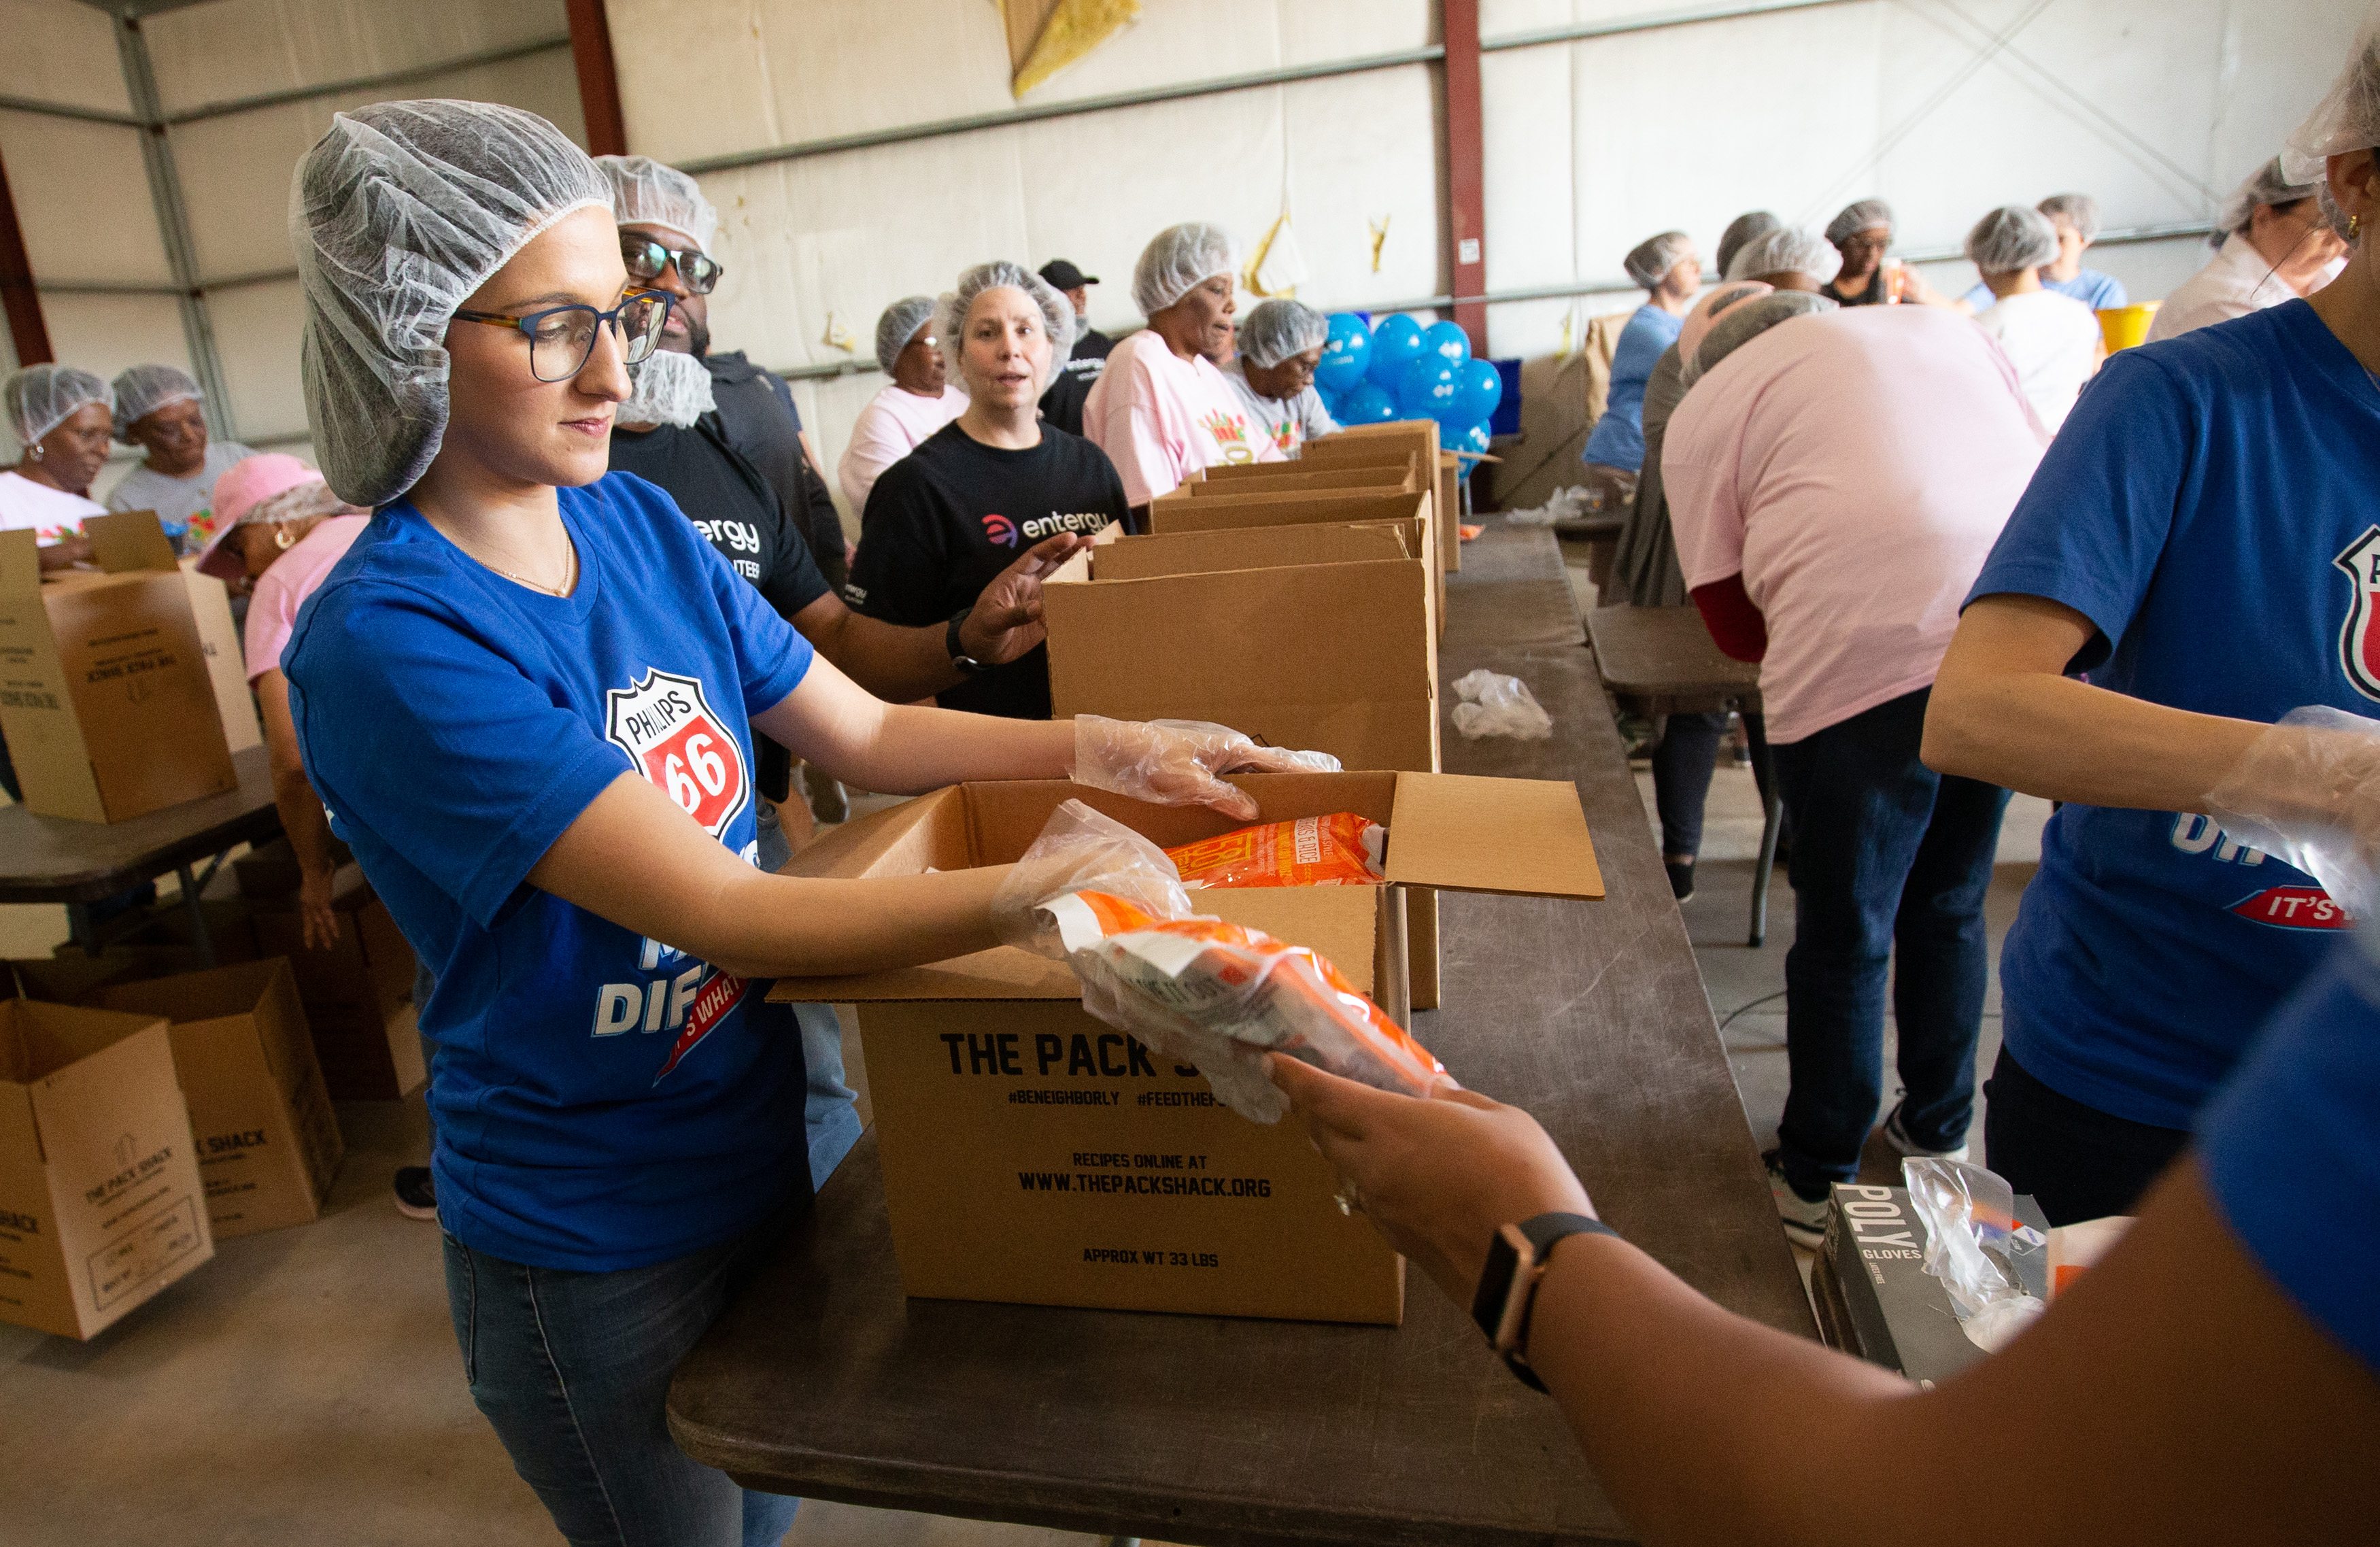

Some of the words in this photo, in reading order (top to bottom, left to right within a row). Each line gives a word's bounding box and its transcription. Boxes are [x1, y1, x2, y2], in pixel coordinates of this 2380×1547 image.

[665, 733, 726, 817] 66
[1299, 843, 1319, 862] RICE
[2267, 896, 2337, 921] IT'S
[940, 1033, 1023, 1076] THE
[1035, 1034, 1156, 1077] PACK
[1008, 1089, 1119, 1106] #BENEIGHBORLY
[207, 1129, 267, 1153] SHACK
[1072, 1153, 1130, 1168] RECIPES
[1134, 1155, 1183, 1169] ONLINE
[1188, 1156, 1207, 1170] AT
[1018, 1172, 1272, 1198] WWW.THEPACKSHACK.ORG
[1836, 1184, 1918, 1248] POLY
[1083, 1248, 1138, 1265] APPROX
[1142, 1251, 1165, 1265] WT
[1170, 1253, 1188, 1266] 33
[1192, 1253, 1219, 1268] LBS
[1863, 1249, 1922, 1259] GLOVES
